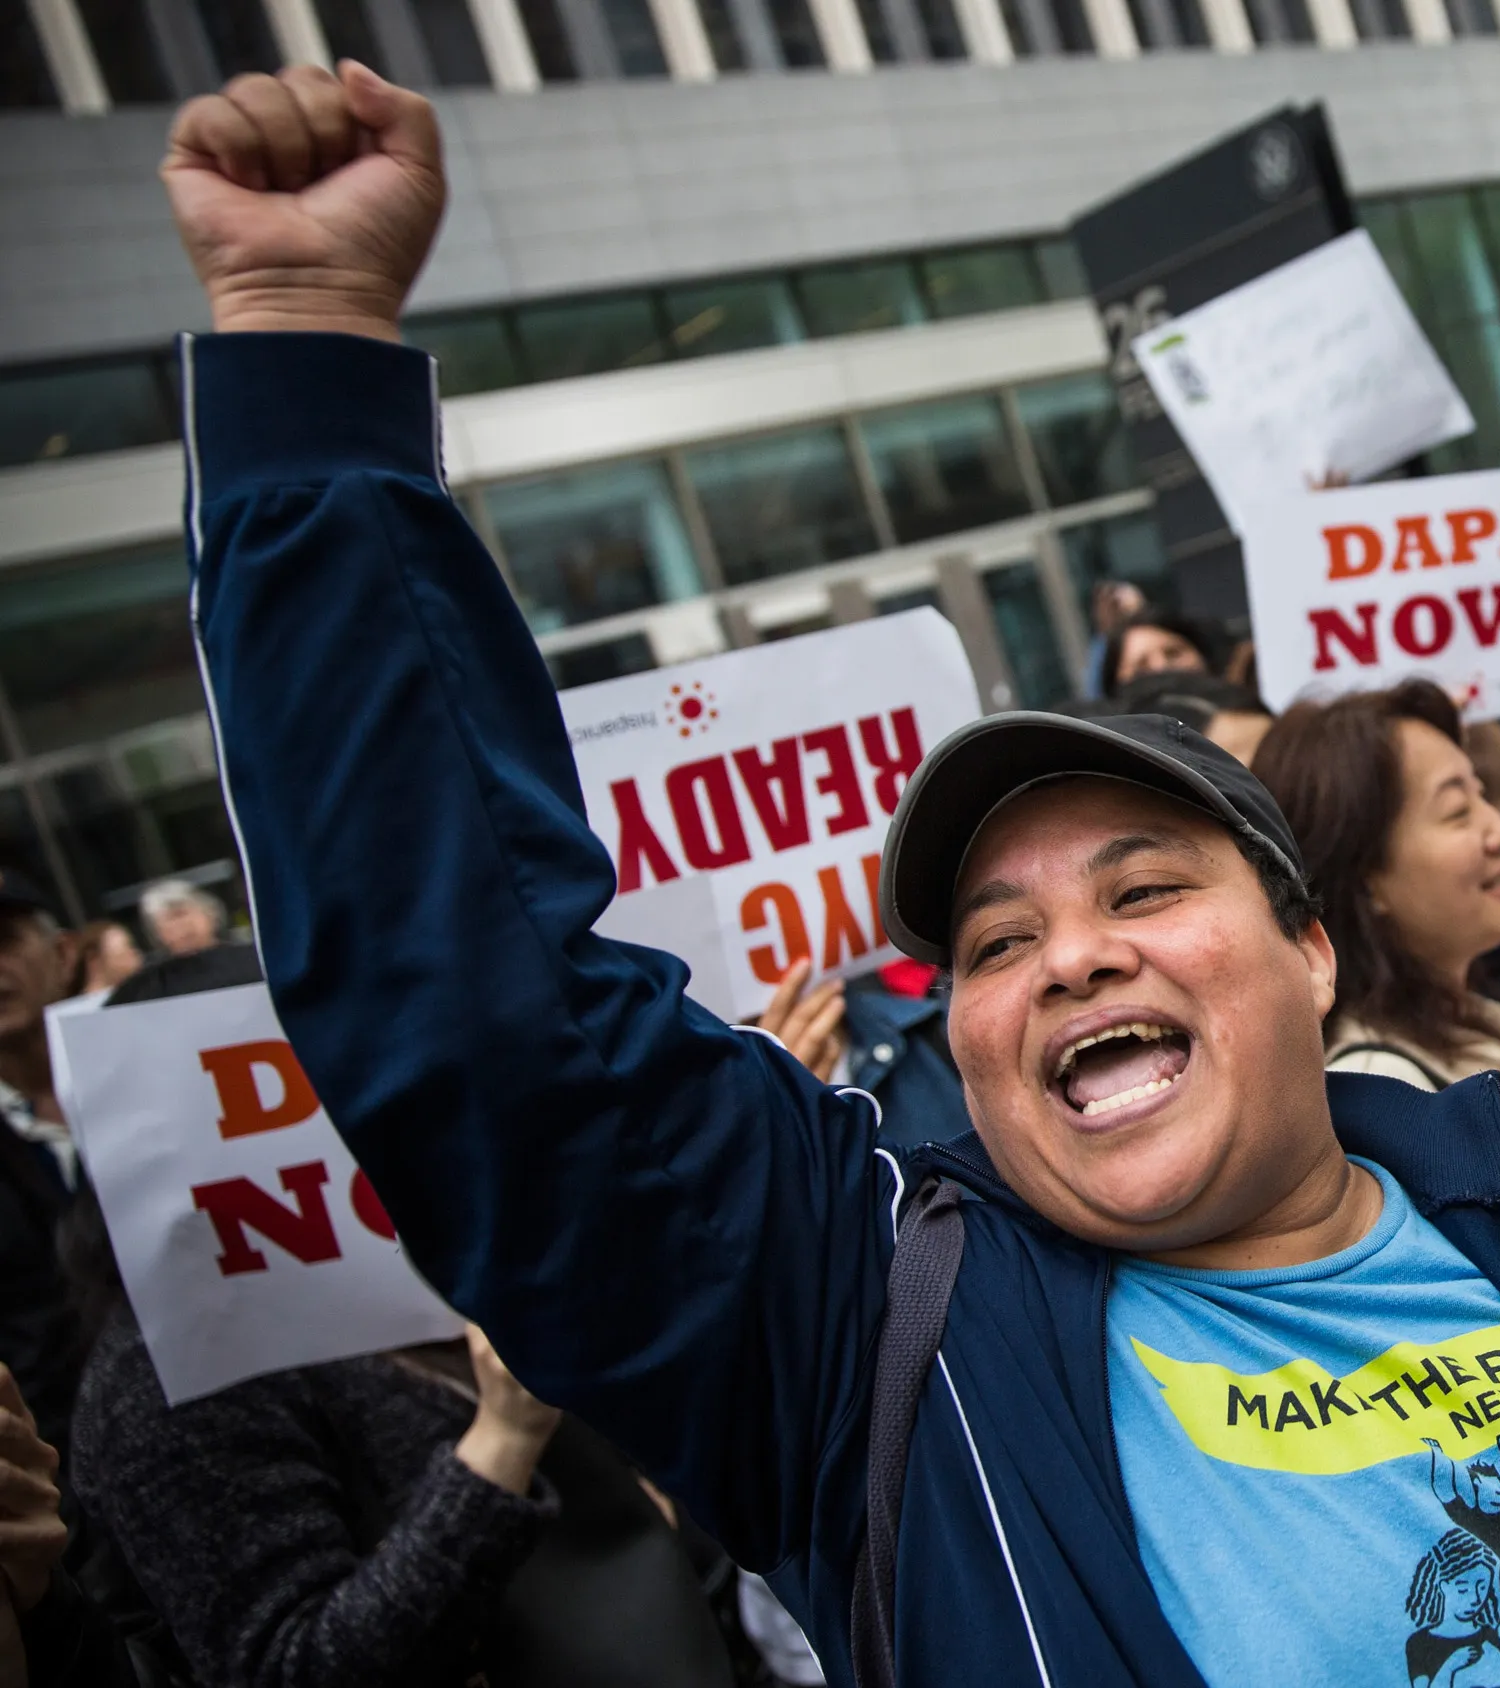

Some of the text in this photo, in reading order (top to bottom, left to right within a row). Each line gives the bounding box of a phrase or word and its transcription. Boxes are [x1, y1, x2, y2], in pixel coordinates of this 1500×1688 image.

[610, 706, 924, 895] READY
[191, 1160, 398, 1278] N
[1369, 1355, 1480, 1421] THE
